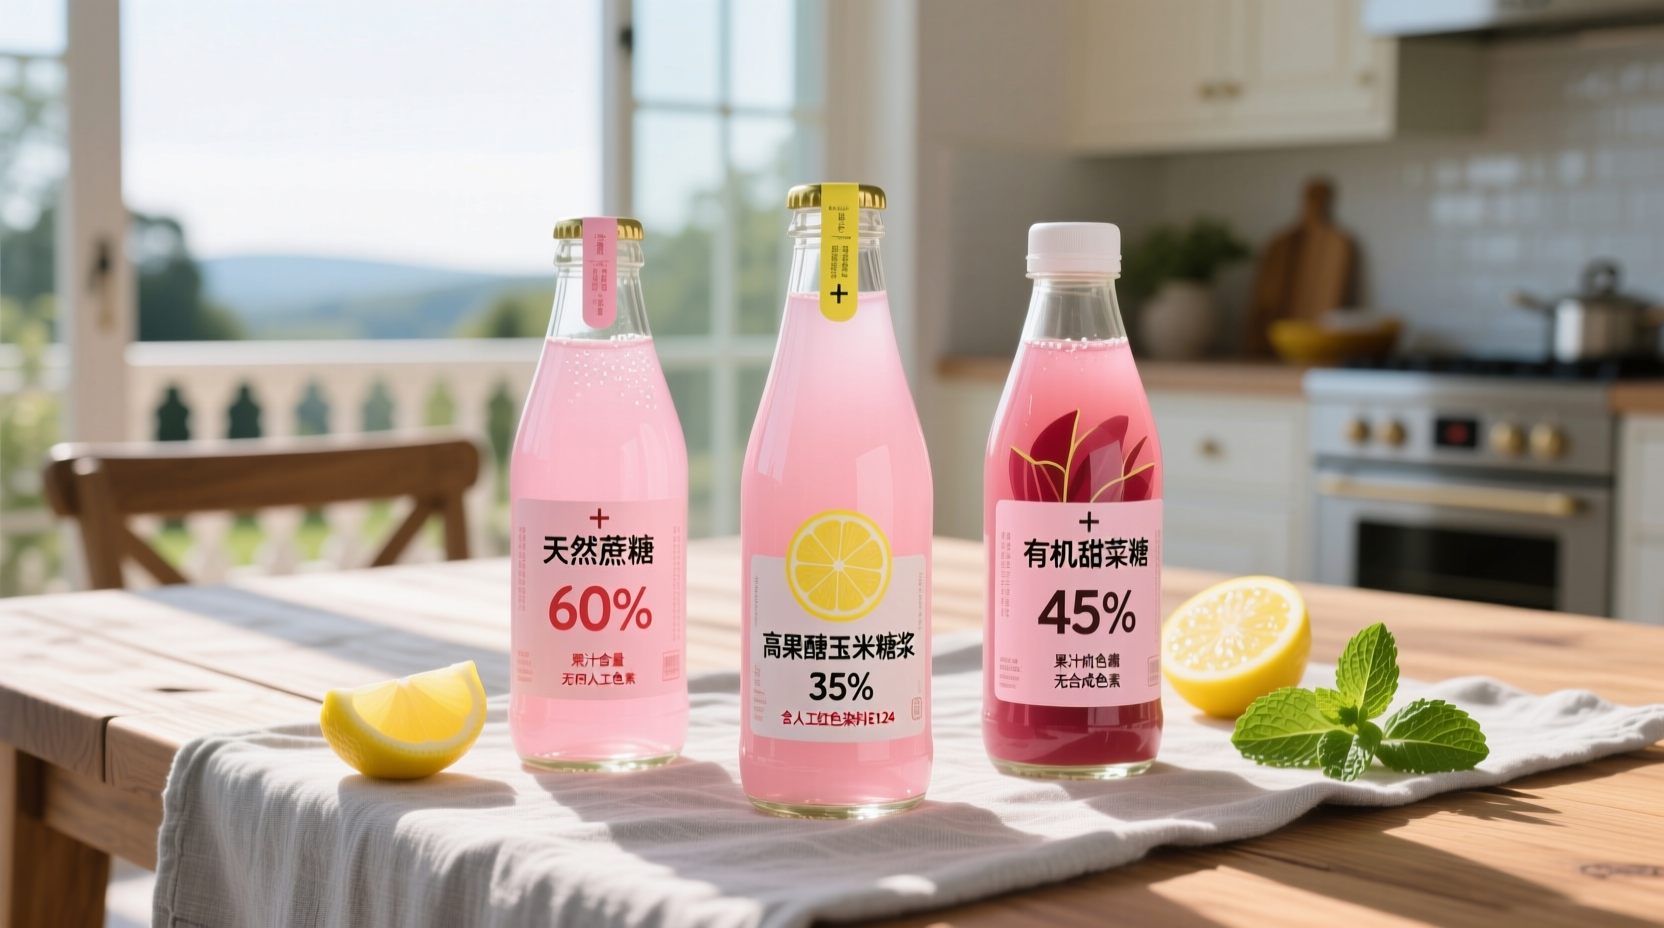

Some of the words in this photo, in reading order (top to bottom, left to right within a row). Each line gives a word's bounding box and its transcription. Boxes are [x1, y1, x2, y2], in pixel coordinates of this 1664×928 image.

[543, 534, 654, 566] 天然蔗糖
[1024, 537, 1148, 569] 有机甜菜糖
[549, 585, 652, 631] 60%
[1038, 590, 1136, 635] 45%
[809, 672, 873, 701] 35%
